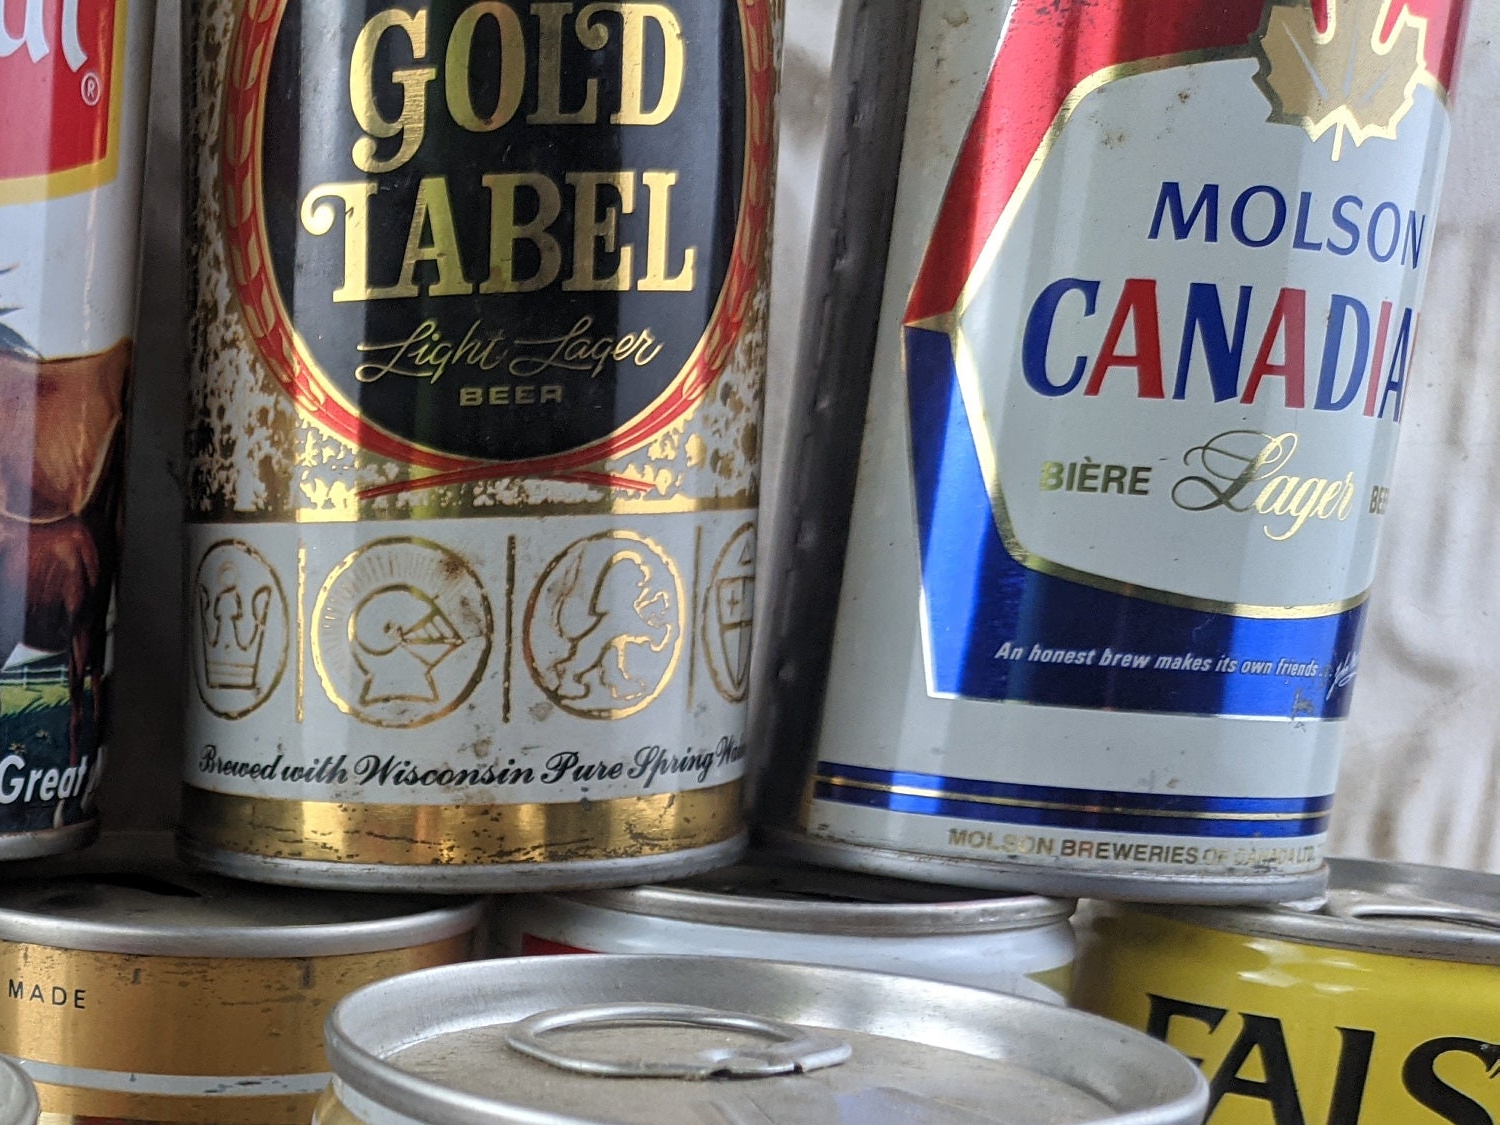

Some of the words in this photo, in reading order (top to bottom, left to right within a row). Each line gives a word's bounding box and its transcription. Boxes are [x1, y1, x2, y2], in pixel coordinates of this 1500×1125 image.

[350, 0, 686, 173] GOLD
[300, 171, 695, 302] LABEL
[1148, 181, 1427, 270] MOLSON
[350, 319, 505, 384] Light
[509, 315, 664, 378] Lager
[1022, 277, 1421, 424] CANADIA
[460, 385, 563, 406] BEER
[1041, 456, 1153, 496] BIÈRE
[1171, 430, 1355, 541] Lager
[994, 641, 1022, 660] An
[1028, 644, 1095, 665] honest
[1100, 648, 1151, 669] brew
[1154, 653, 1212, 673] makes
[1215, 655, 1238, 673] its
[1241, 661, 1273, 675] own
[200, 744, 283, 781] Brewed
[281, 755, 348, 784] with
[353, 754, 535, 786] Wisconsin
[541, 751, 622, 784] Pure
[625, 745, 714, 788] Spring
[948, 828, 1055, 856] MOLSON
[1060, 839, 1199, 865] BREWERIES
[8, 978, 86, 1010] MADE
